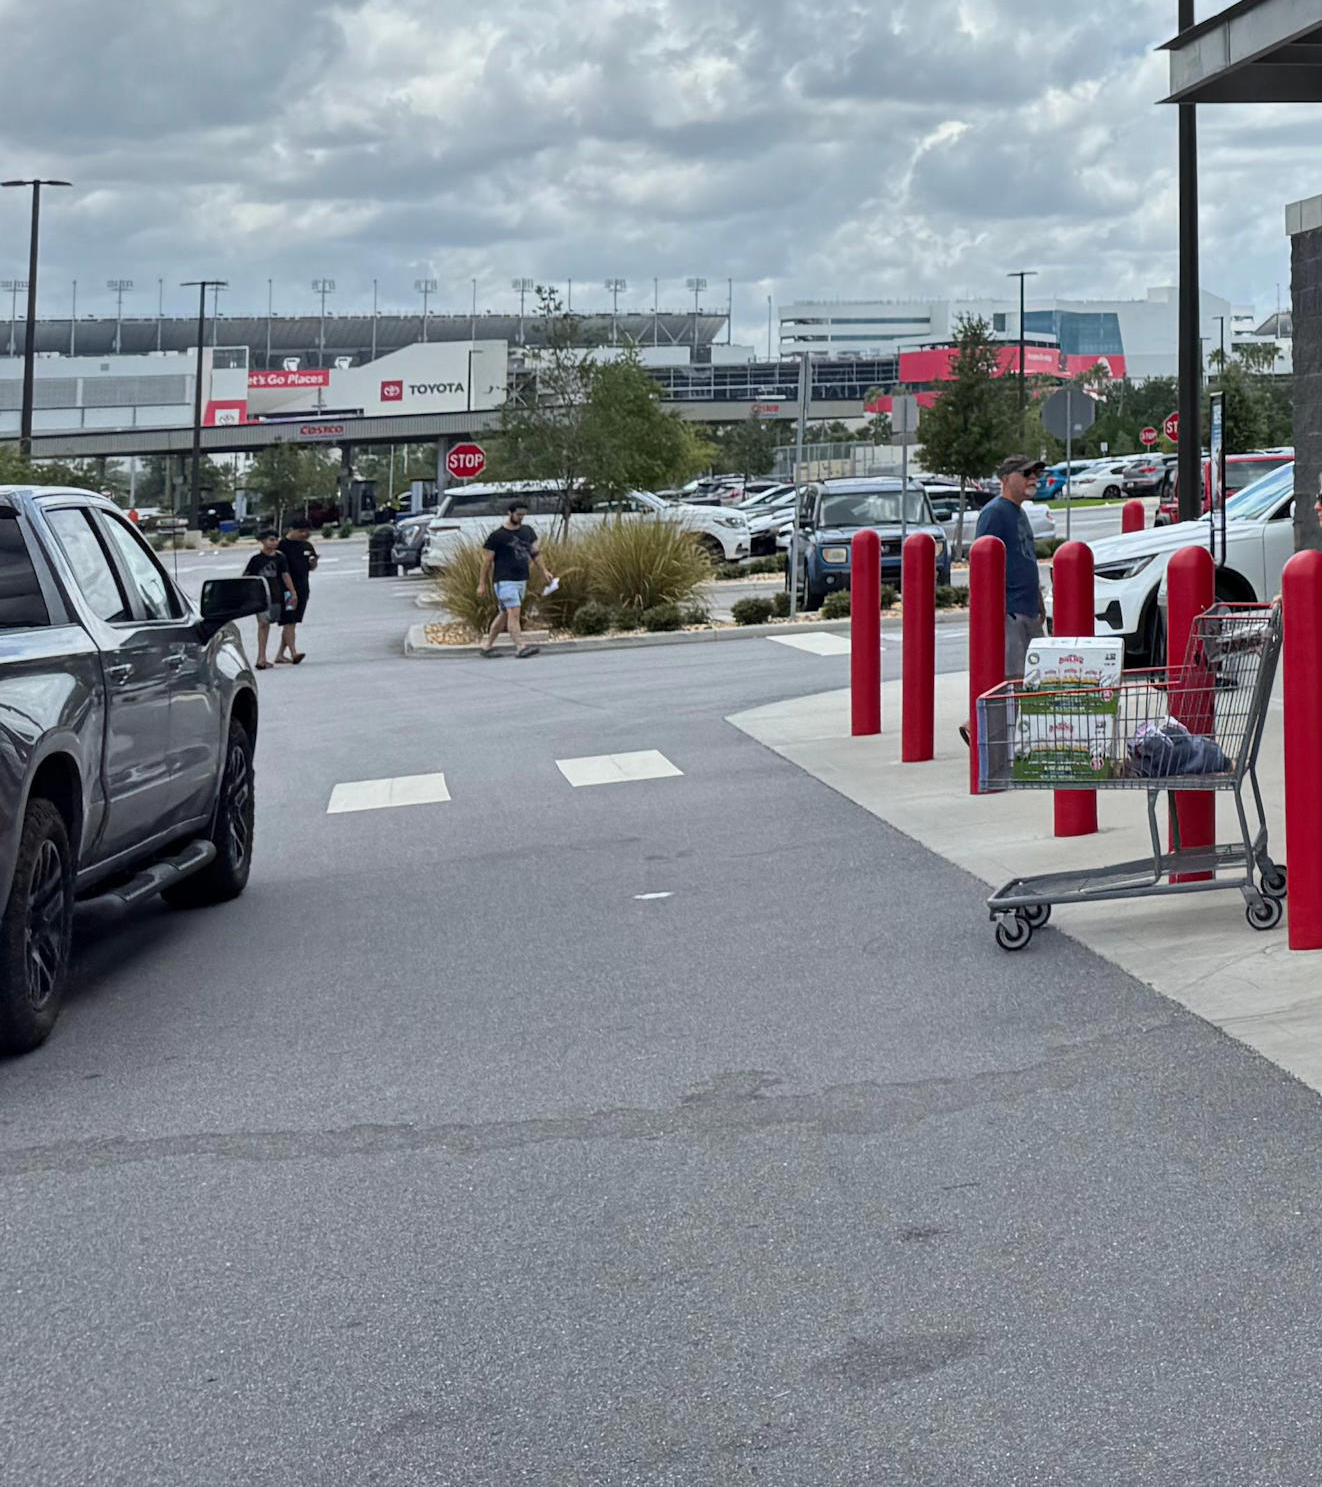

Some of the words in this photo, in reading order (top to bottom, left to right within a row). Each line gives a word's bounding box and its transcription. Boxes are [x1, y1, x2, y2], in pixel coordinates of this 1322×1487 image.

[267, 374, 285, 385] Go
[287, 373, 324, 384] Places
[409, 383, 465, 395] TOYOTA
[301, 425, 344, 435] COSTCO
[1166, 421, 1178, 433] ST
[449, 453, 484, 469] STOP
